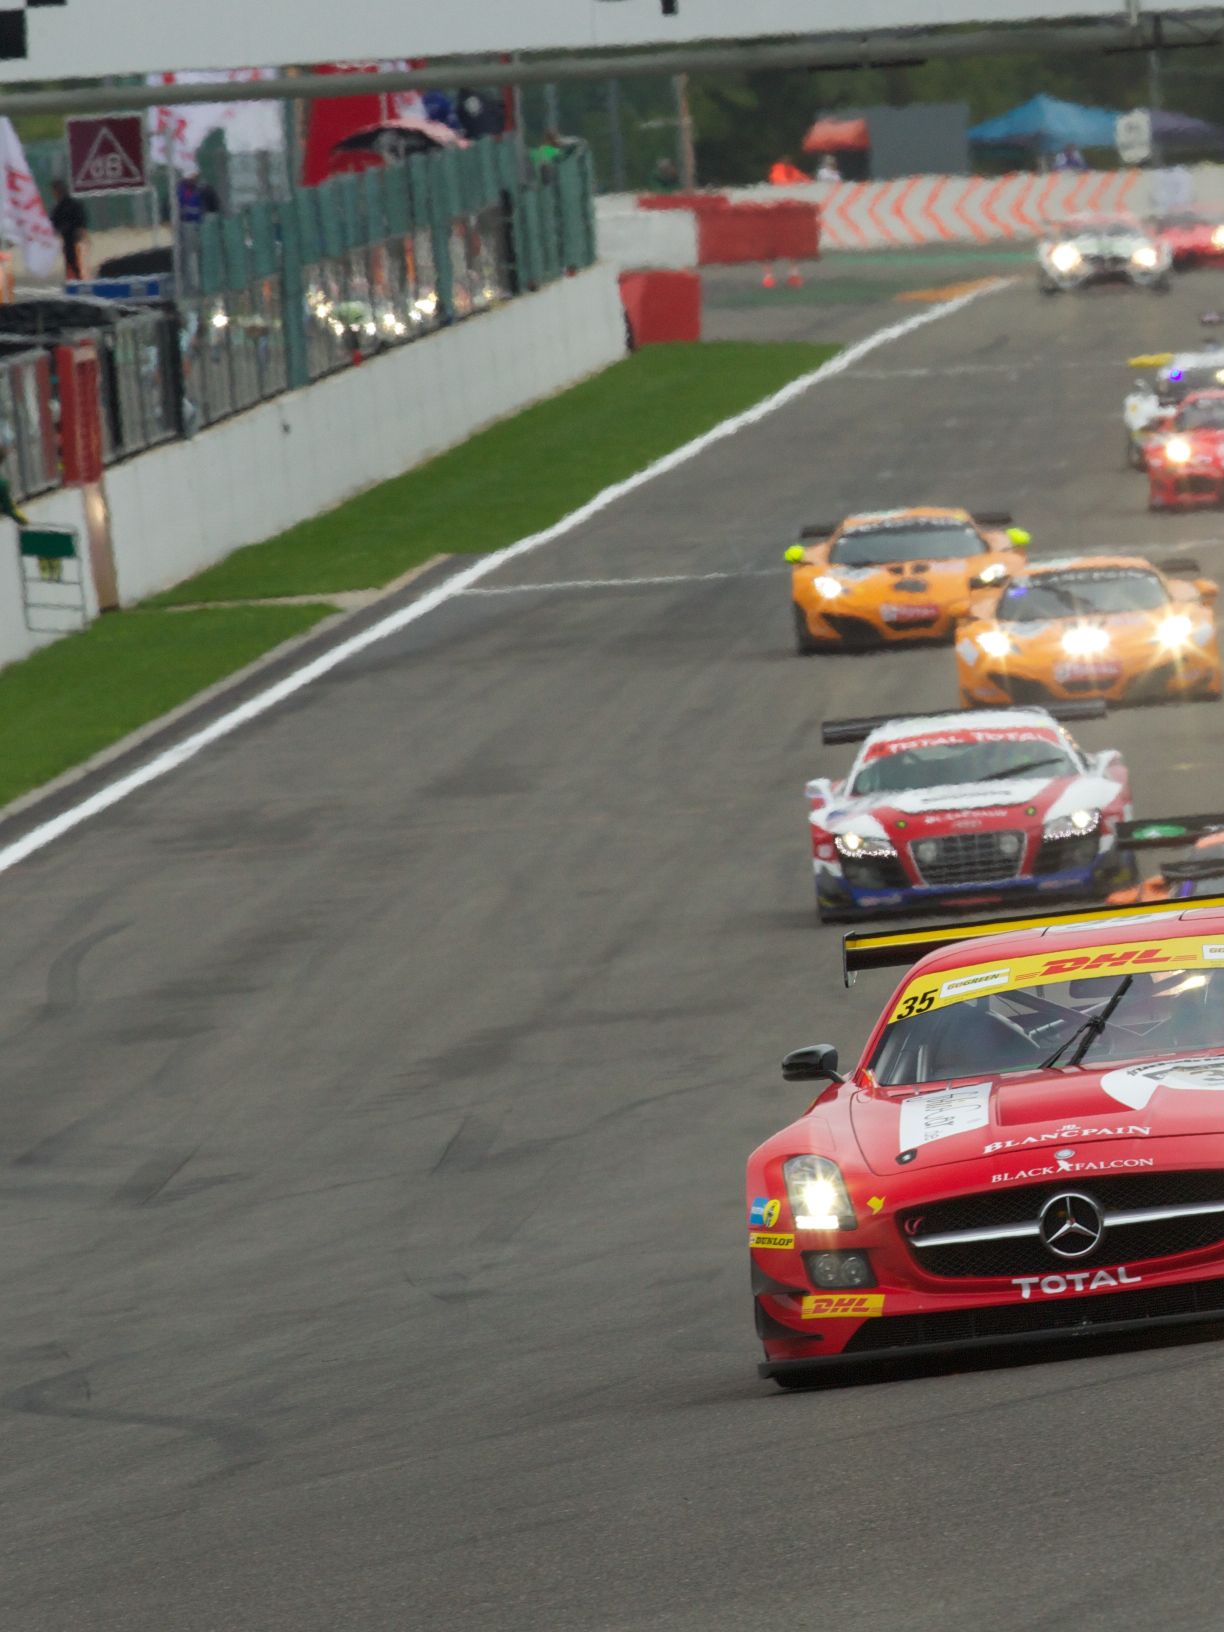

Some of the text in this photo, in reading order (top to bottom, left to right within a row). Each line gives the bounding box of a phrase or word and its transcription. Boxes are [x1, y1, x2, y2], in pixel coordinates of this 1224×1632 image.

[896, 988, 939, 1020] 35
[1040, 949, 1175, 977] DHL
[982, 1125, 1153, 1155] BLANCPAIN
[991, 1158, 1154, 1184] BLACK FALCON
[755, 1236, 793, 1246] DUNLOP
[1011, 1266, 1142, 1300] TOTAL
[812, 1297, 870, 1314] DHL
